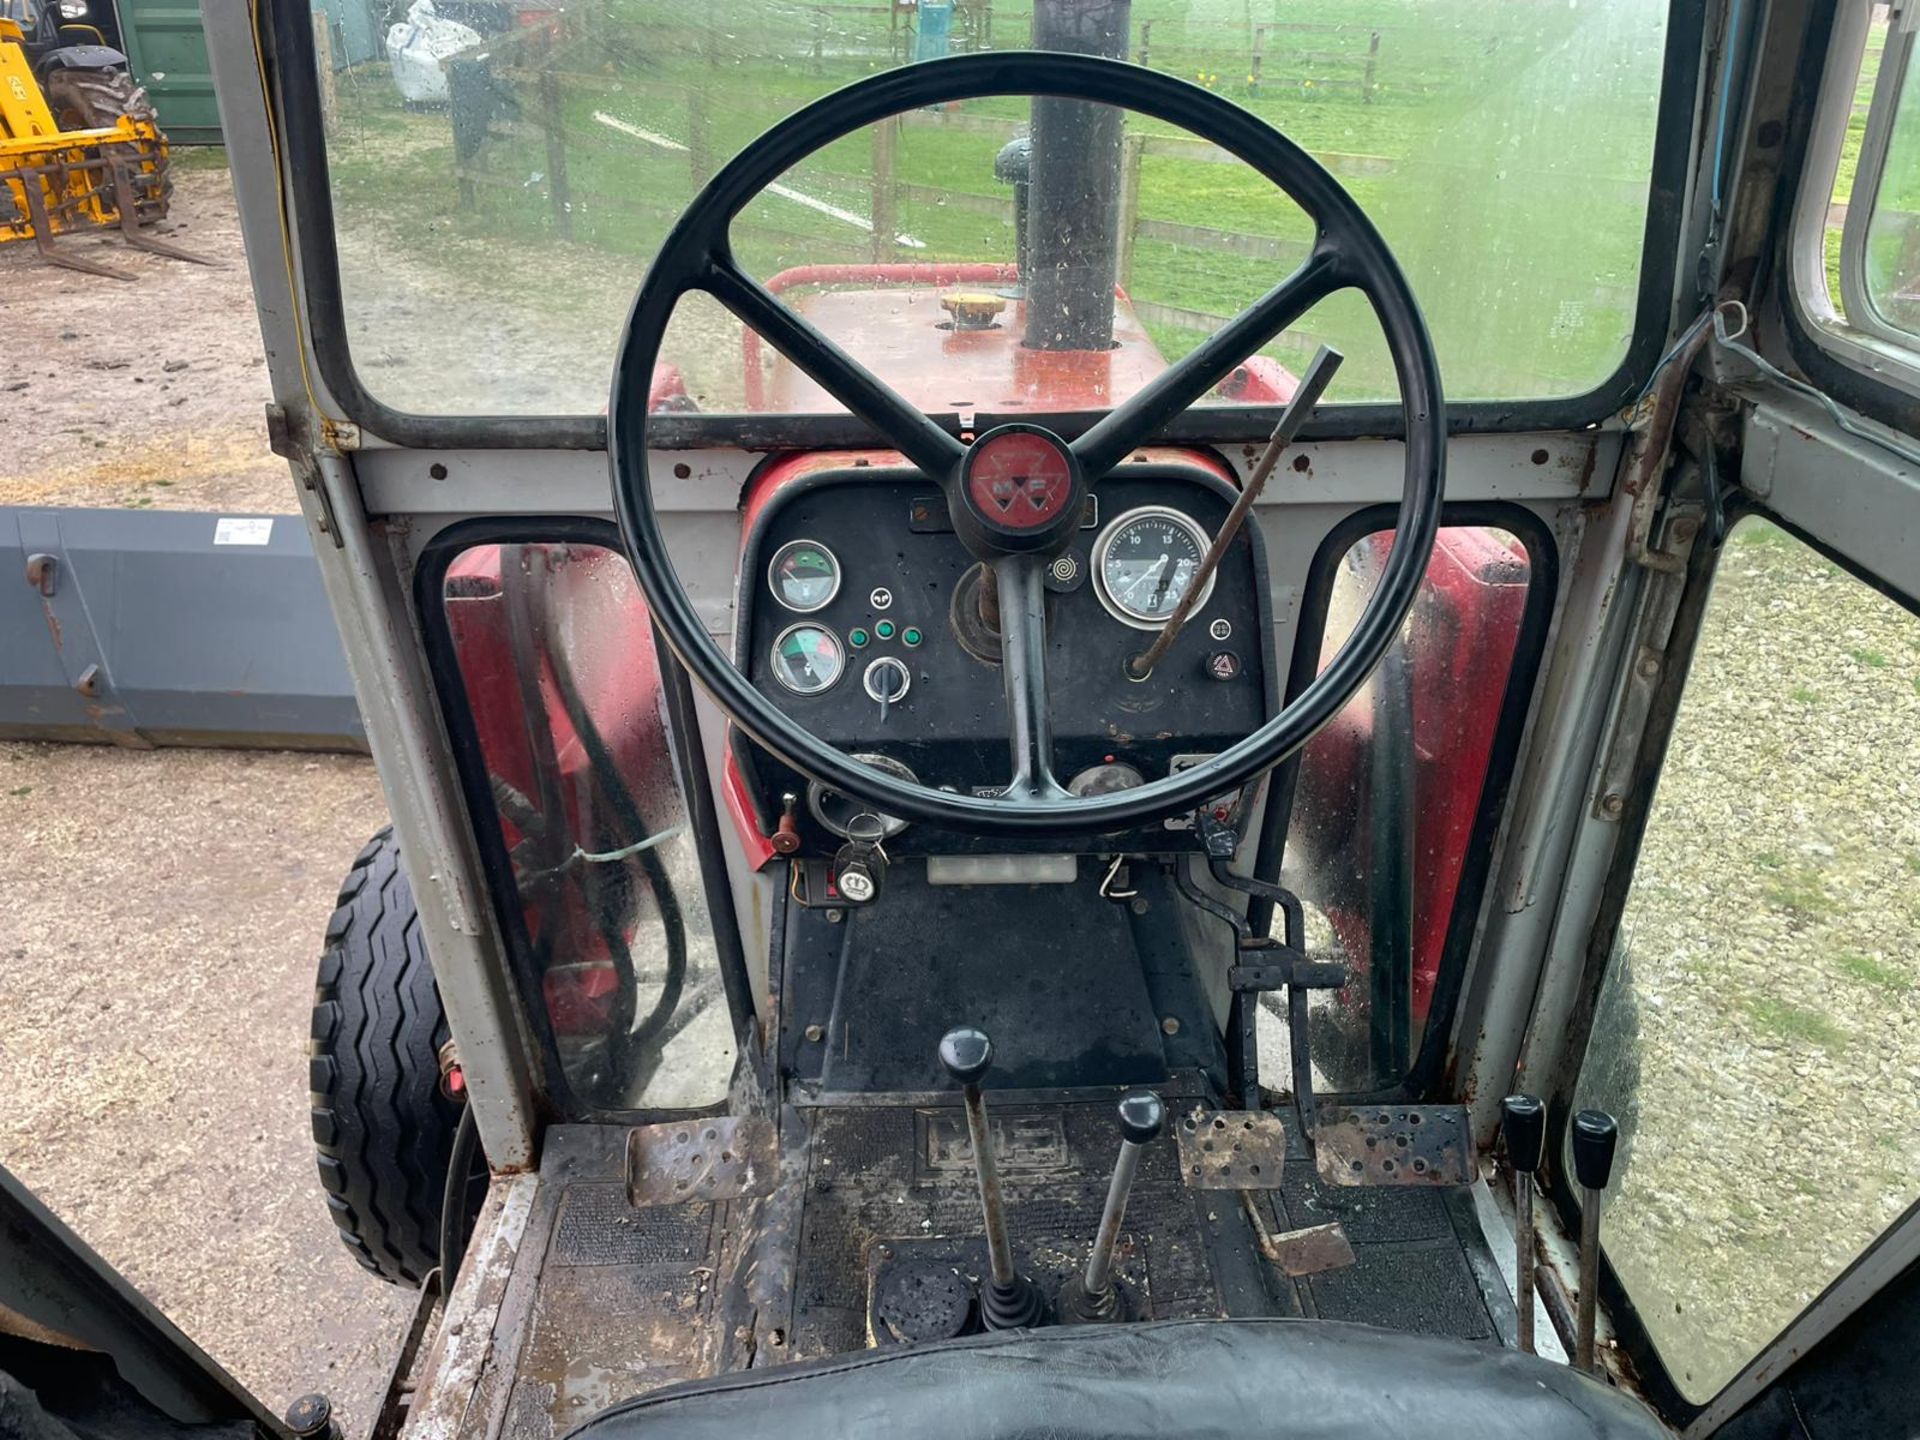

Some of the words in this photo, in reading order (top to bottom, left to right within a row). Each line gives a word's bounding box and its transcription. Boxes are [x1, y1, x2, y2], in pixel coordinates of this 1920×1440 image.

[1129, 535, 1141, 545] 10
[1162, 535, 1173, 544] 15
[1114, 560, 1122, 569] 5
[1176, 558, 1191, 567] 20
[1127, 592, 1134, 600] 0
[1164, 591, 1178, 600] 25
